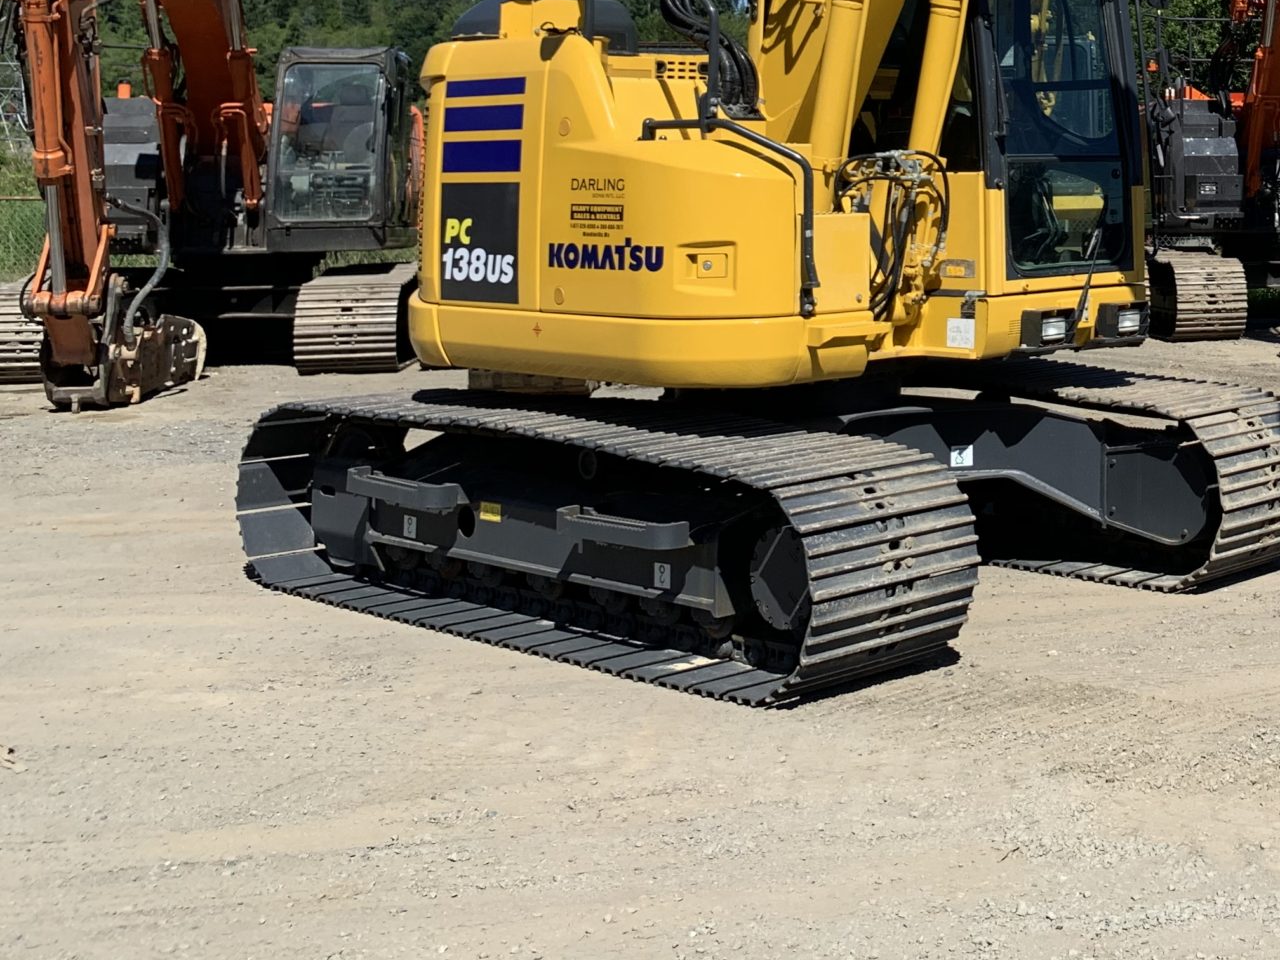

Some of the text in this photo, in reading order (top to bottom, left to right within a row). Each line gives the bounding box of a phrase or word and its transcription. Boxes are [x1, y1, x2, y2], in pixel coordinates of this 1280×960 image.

[571, 178, 625, 191] DARLING
[444, 217, 473, 245] PC
[442, 247, 515, 284] 138US
[548, 237, 665, 272] KOMATSU
